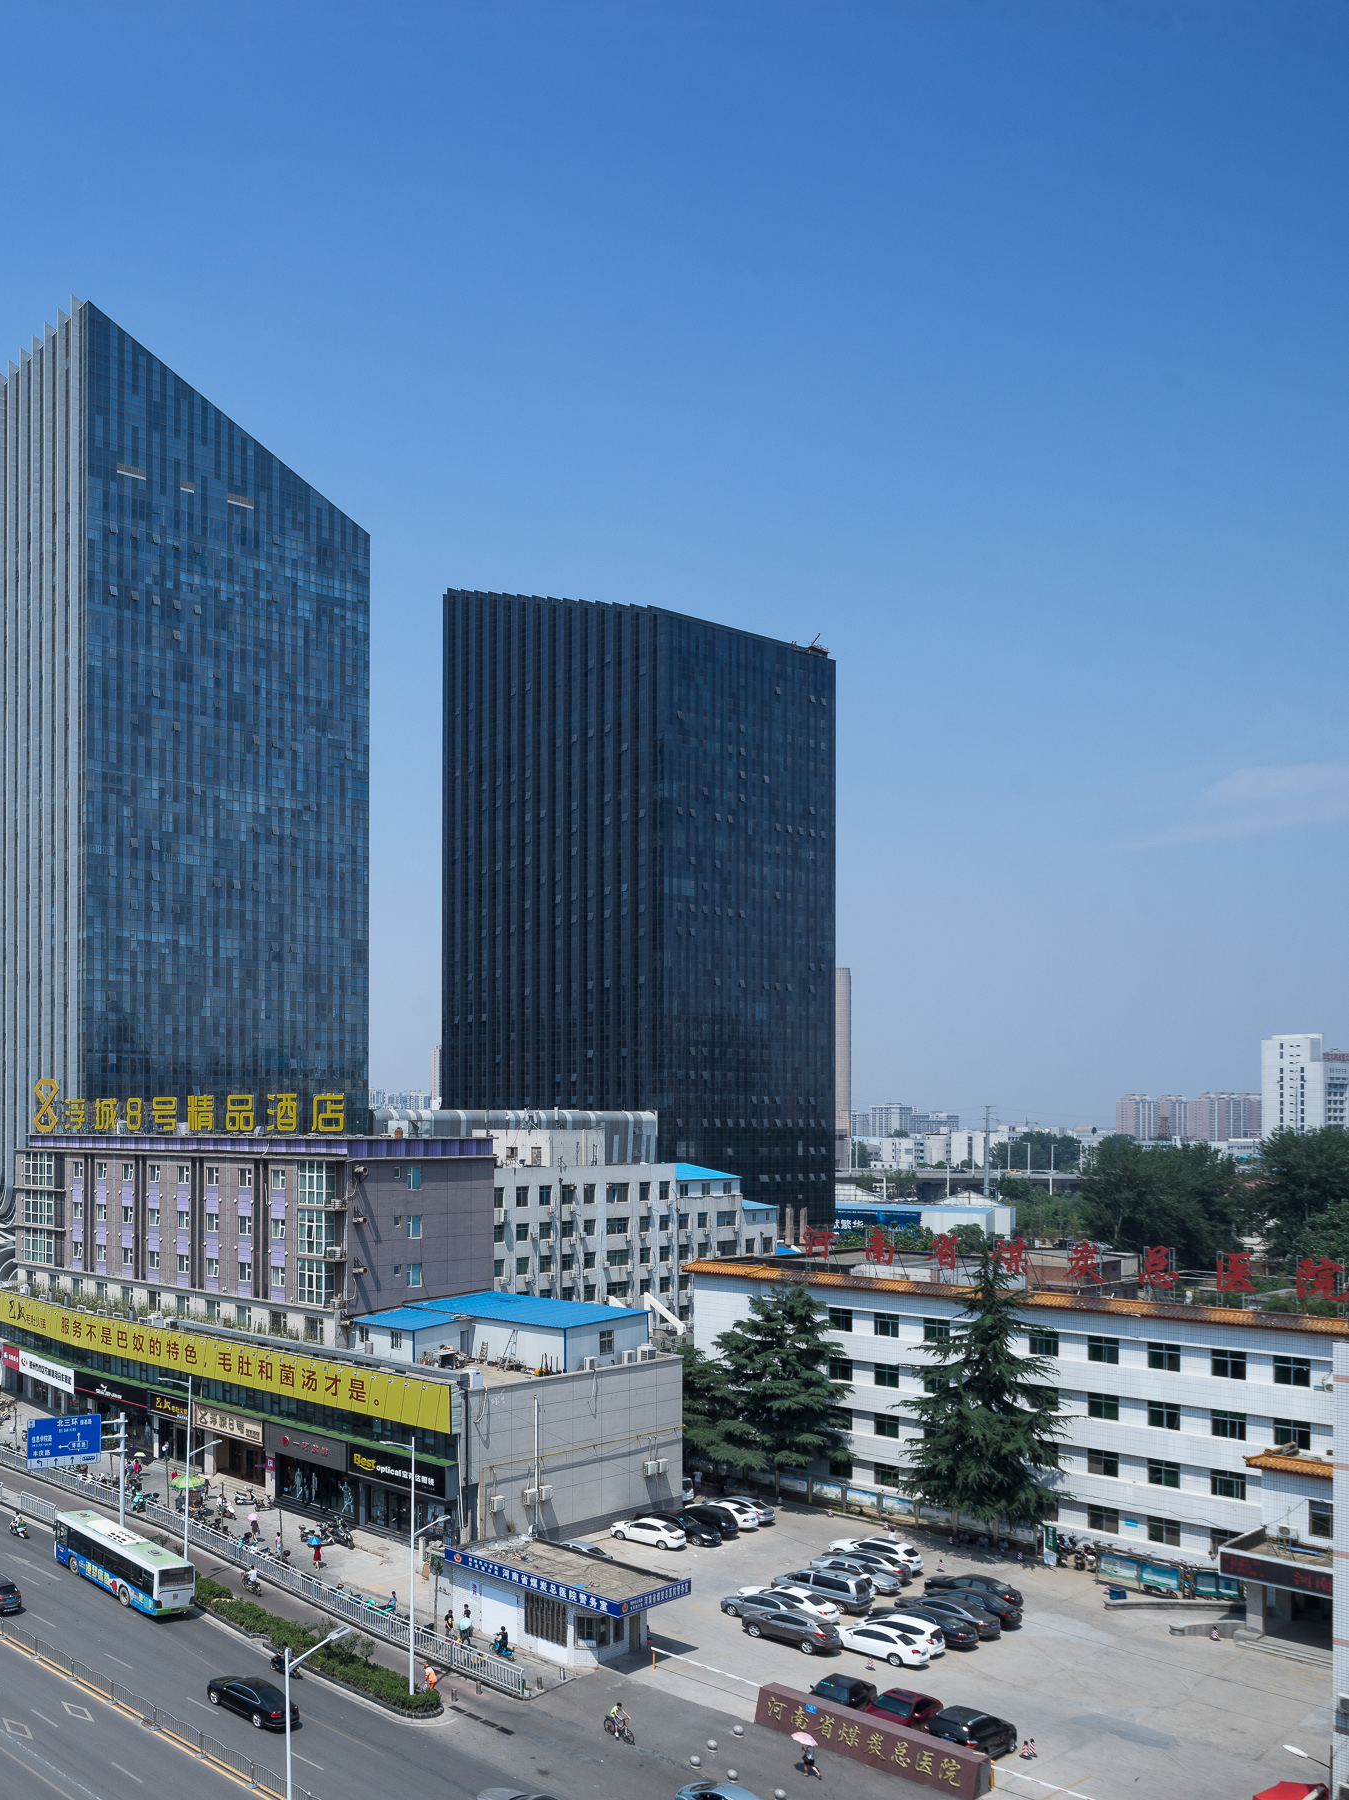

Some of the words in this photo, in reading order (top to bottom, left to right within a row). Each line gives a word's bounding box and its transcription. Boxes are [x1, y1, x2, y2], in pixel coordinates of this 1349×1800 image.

[64, 1092, 345, 1132] 浮城8号精品酒店
[803, 1225, 1349, 1301] 河南省煤炭总医院
[353, 1453, 376, 1470] Best
[376, 1464, 402, 1477] optical
[502, 1568, 609, 1612] 河南省煤炭总医院警务室
[766, 1695, 962, 1788] 河南省煤炭总医院
